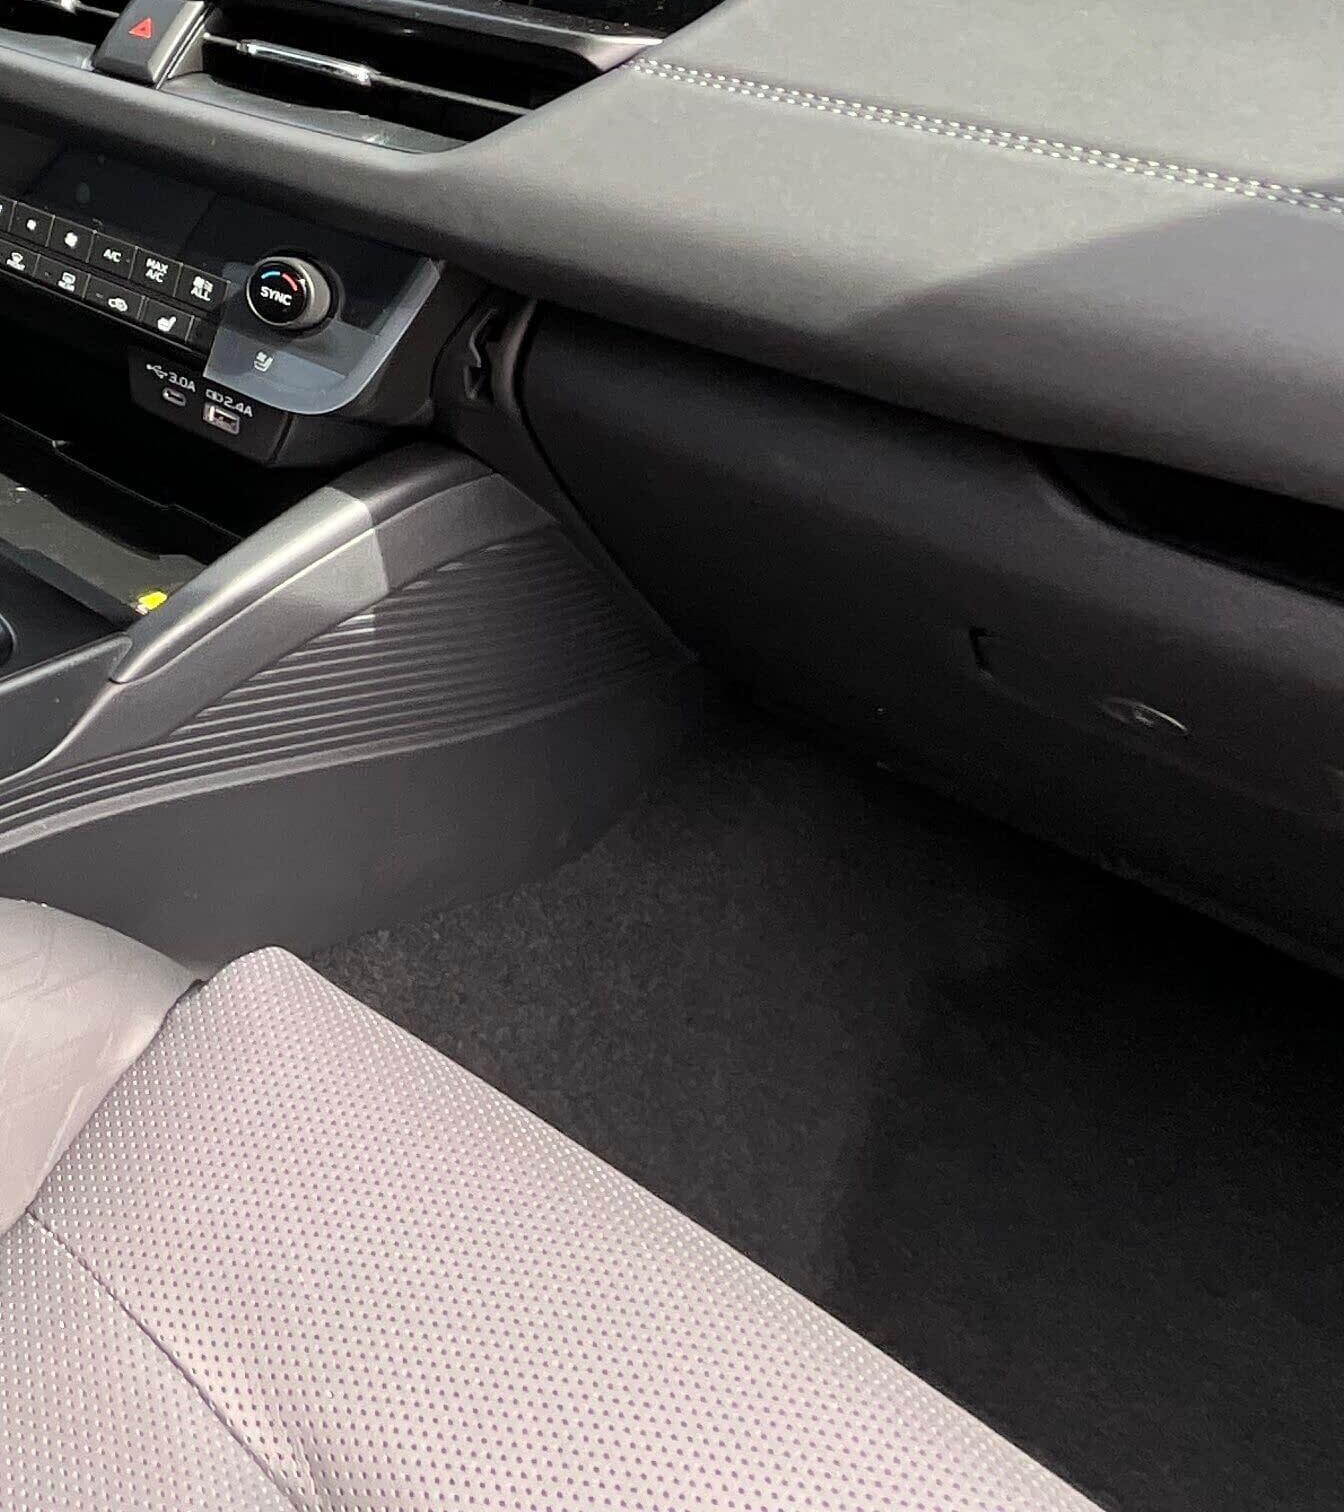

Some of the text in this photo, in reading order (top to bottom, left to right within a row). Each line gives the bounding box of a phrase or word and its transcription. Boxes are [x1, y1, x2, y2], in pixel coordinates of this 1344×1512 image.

[102, 248, 122, 264] A/C
[145, 257, 169, 275] MAX
[144, 268, 164, 284] A/C
[190, 287, 212, 302] ALL
[259, 285, 293, 307] SYNC
[168, 371, 196, 393] 3.0A
[223, 395, 254, 418] 2.4A
